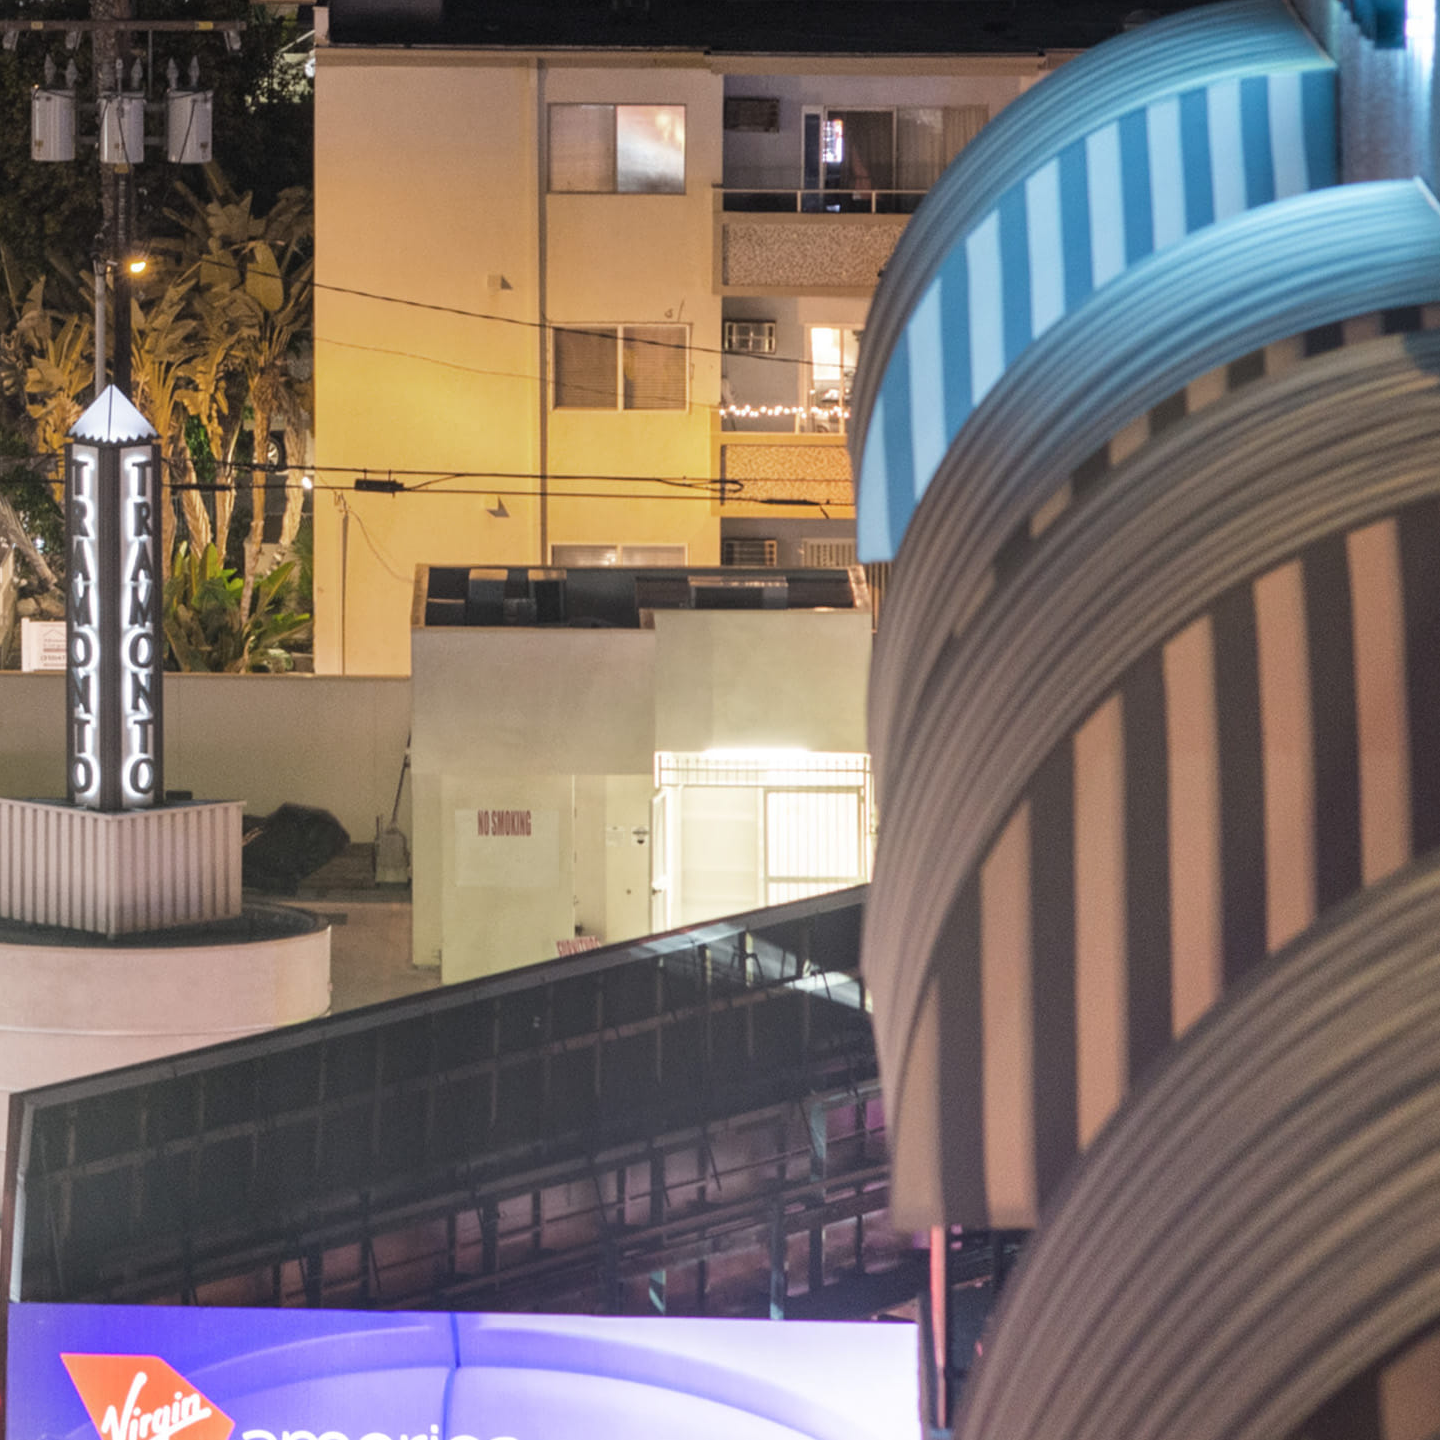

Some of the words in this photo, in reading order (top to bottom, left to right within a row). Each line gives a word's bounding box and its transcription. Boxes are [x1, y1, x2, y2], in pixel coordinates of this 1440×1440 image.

[70, 457, 100, 796] TRAMONTO
[124, 457, 156, 796] TRAMONTO
[477, 810, 490, 836] NO
[491, 810, 532, 836] SMOKING
[101, 1371, 212, 1440] Virgin
